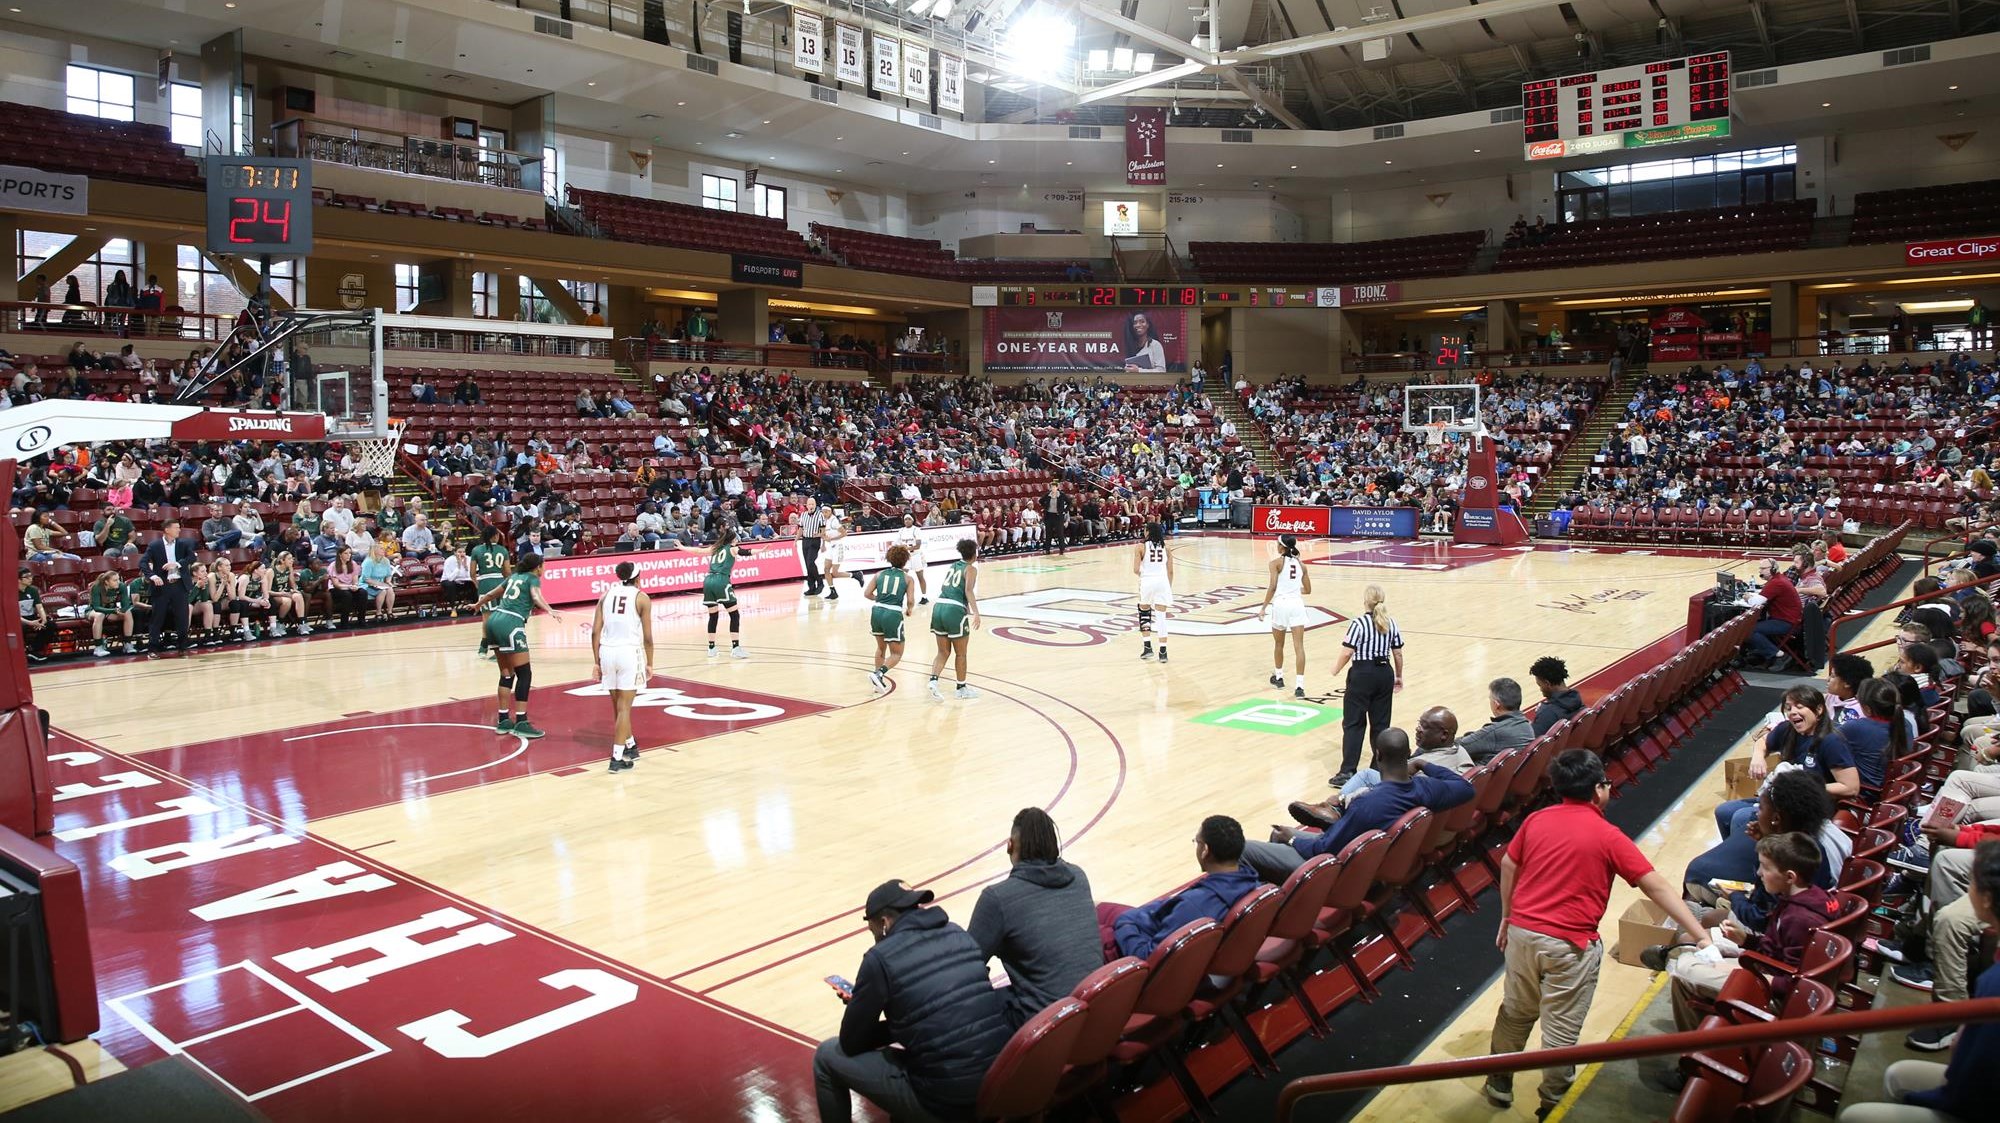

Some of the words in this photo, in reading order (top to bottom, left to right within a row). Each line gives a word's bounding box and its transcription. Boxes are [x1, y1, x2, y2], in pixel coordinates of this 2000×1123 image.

[802, 37, 815, 54] 13
[843, 48, 856, 66] 15
[880, 60, 892, 76] 22
[910, 67, 922, 84] 40
[946, 78, 956, 94] 14
[1584, 101, 1590, 110] 2
[1580, 113, 1590, 122] 38
[1656, 115, 1667, 125] 00
[1531, 142, 1562, 156] Coca-Cola
[1570, 140, 1591, 150] zero
[1593, 138, 1619, 148] SUGAR
[1128, 160, 1165, 172] Charleston
[242, 166, 298, 188] 7:11
[0, 179, 75, 200] PORTS
[230, 198, 290, 243] 24
[1909, 247, 1954, 258] Great
[1958, 242, 1997, 256] Clips
[744, 265, 780, 276] FLOSPORTS
[784, 269, 798, 278] LIVE
[1028, 293, 1035, 304] 3
[1093, 288, 1114, 305] 22
[1180, 288, 1194, 304] 18
[1306, 292, 1314, 303] 2
[1354, 285, 1386, 298] TBONZ
[1252, 294, 1257, 305] 3
[1276, 294, 1284, 306] 0
[997, 342, 1078, 353] ONE-YEAR
[1086, 342, 1120, 353] MBA
[1442, 336, 1460, 344] 7:11
[1438, 348, 1458, 364] 24
[229, 417, 292, 432] SPALDING
[1266, 511, 1316, 532] Chick-fil-A
[929, 534, 954, 543] HUDSON
[484, 553, 504, 568] 30
[1150, 550, 1162, 562] 25
[544, 568, 568, 580] GET
[570, 566, 594, 578] THE
[760, 548, 793, 560] NISSAN
[943, 568, 962, 588] 20
[1290, 565, 1296, 579] 2
[882, 575, 900, 596] 11
[612, 596, 626, 614] 15
